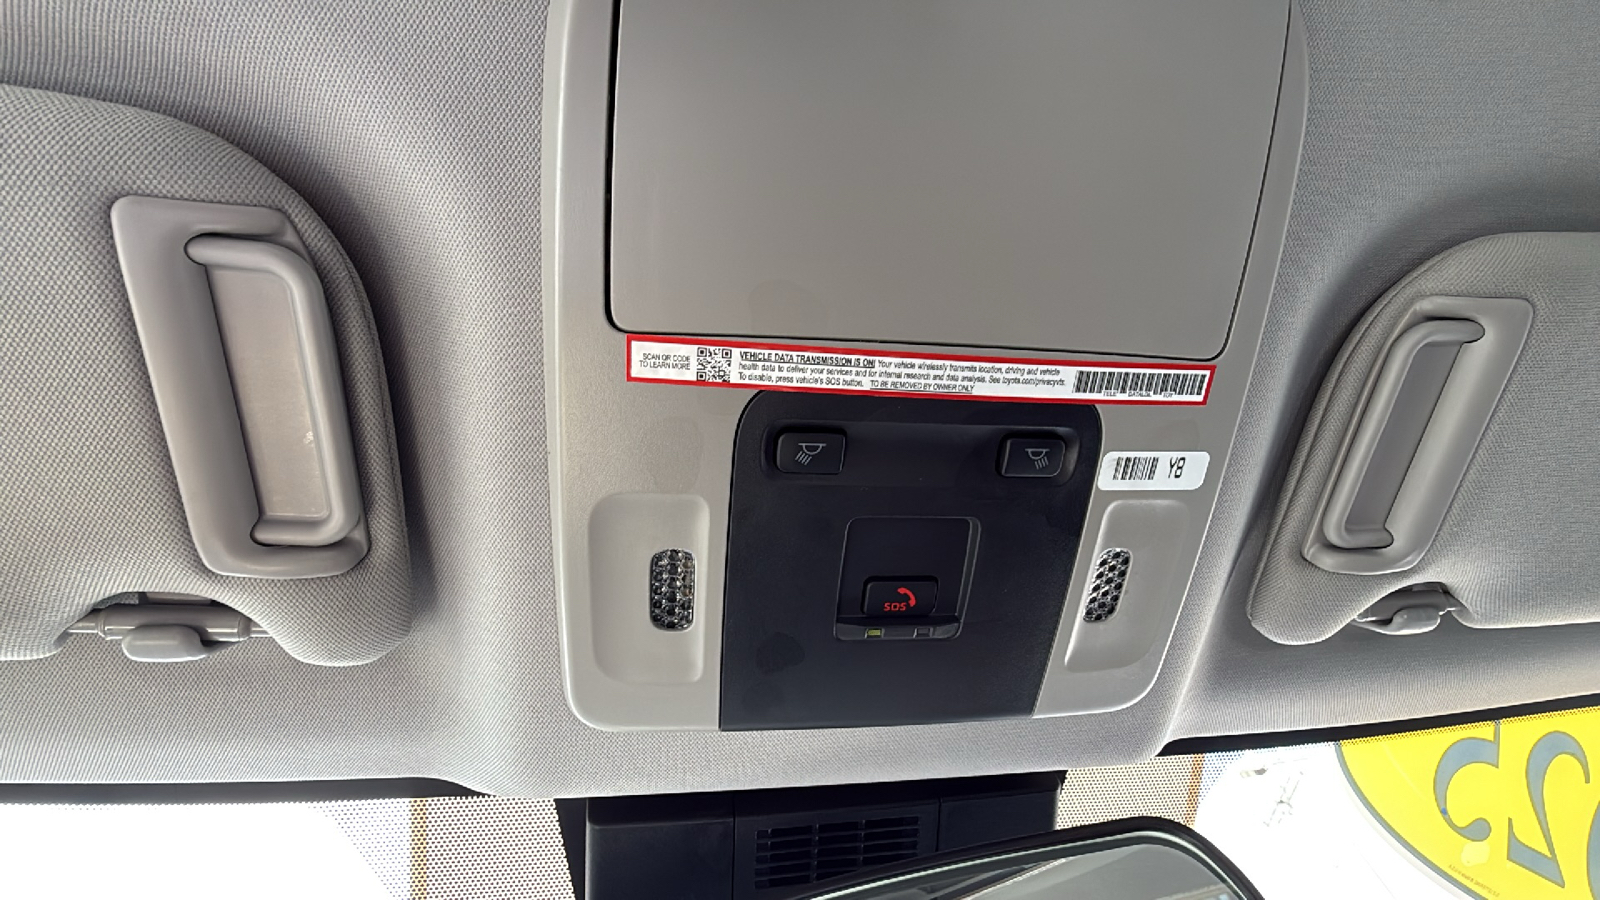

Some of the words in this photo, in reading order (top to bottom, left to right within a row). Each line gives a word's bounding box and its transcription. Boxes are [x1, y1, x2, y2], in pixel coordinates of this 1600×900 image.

[642, 352, 660, 360] SCAN
[650, 361, 670, 369] LEARN
[672, 362, 690, 370] MORE
[740, 352, 772, 360] VEHICLE
[774, 353, 793, 362] DATA
[796, 354, 852, 366] TRANSMISSION
[854, 358, 861, 366] IS
[862, 358, 876, 367] ON!
[894, 361, 916, 369] vehicle
[917, 362, 948, 373] wirelessly
[949, 364, 978, 372] transmits
[978, 365, 1003, 374] location,
[1005, 366, 1025, 376] driving
[1026, 367, 1038, 375] and
[1040, 368, 1060, 376] vehicle
[738, 372, 746, 380] To
[748, 372, 774, 383] disable,
[775, 376, 794, 385] press
[796, 376, 824, 385] vehicle's
[825, 377, 840, 386] SOS
[842, 378, 864, 387] button.
[739, 362, 759, 371] health
[762, 364, 776, 372] data
[778, 364, 784, 372] to
[786, 365, 808, 374] deliver
[810, 368, 824, 376] your
[826, 367, 852, 376] services
[854, 368, 867, 377] and
[868, 369, 878, 378] for
[878, 370, 902, 379] internal
[904, 372, 930, 380] research
[932, 372, 944, 380] and
[946, 373, 960, 381] data
[961, 374, 986, 384] analysis.
[988, 375, 1001, 384] See
[890, 381, 922, 390] REMOVED
[932, 383, 956, 391] OWNER
[958, 384, 975, 392] ONLY
[1168, 456, 1186, 479] Y8
[883, 602, 907, 612] SOS
